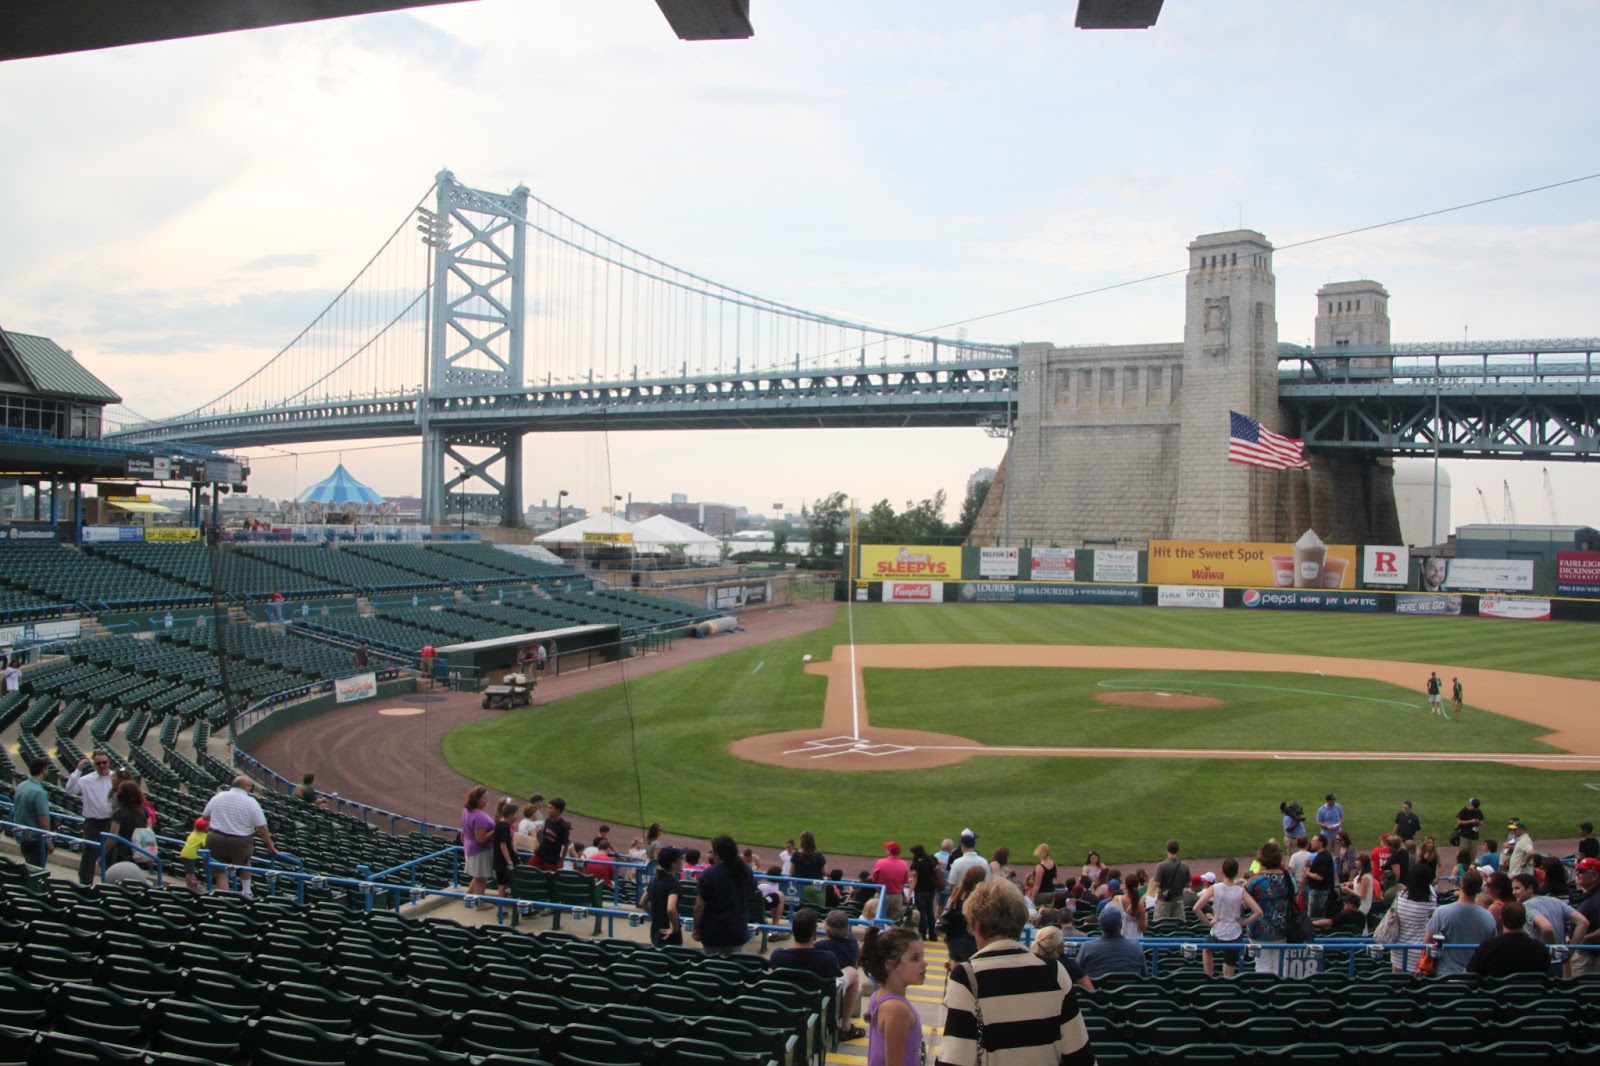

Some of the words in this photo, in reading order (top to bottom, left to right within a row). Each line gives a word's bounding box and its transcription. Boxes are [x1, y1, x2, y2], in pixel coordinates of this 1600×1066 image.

[1153, 547, 1171, 558] Hit
[1175, 548, 1194, 559] the
[1199, 548, 1234, 559] Sweet
[1238, 549, 1264, 562] Spot
[1375, 552, 1397, 572] R
[1191, 570, 1224, 580] Wawa
[977, 584, 1016, 593] LOURDES
[1261, 593, 1296, 605] pepsi
[1360, 598, 1377, 606] ETC.
[1396, 603, 1417, 612] HERE
[1418, 602, 1431, 611] WE
[1432, 601, 1446, 610] GO
